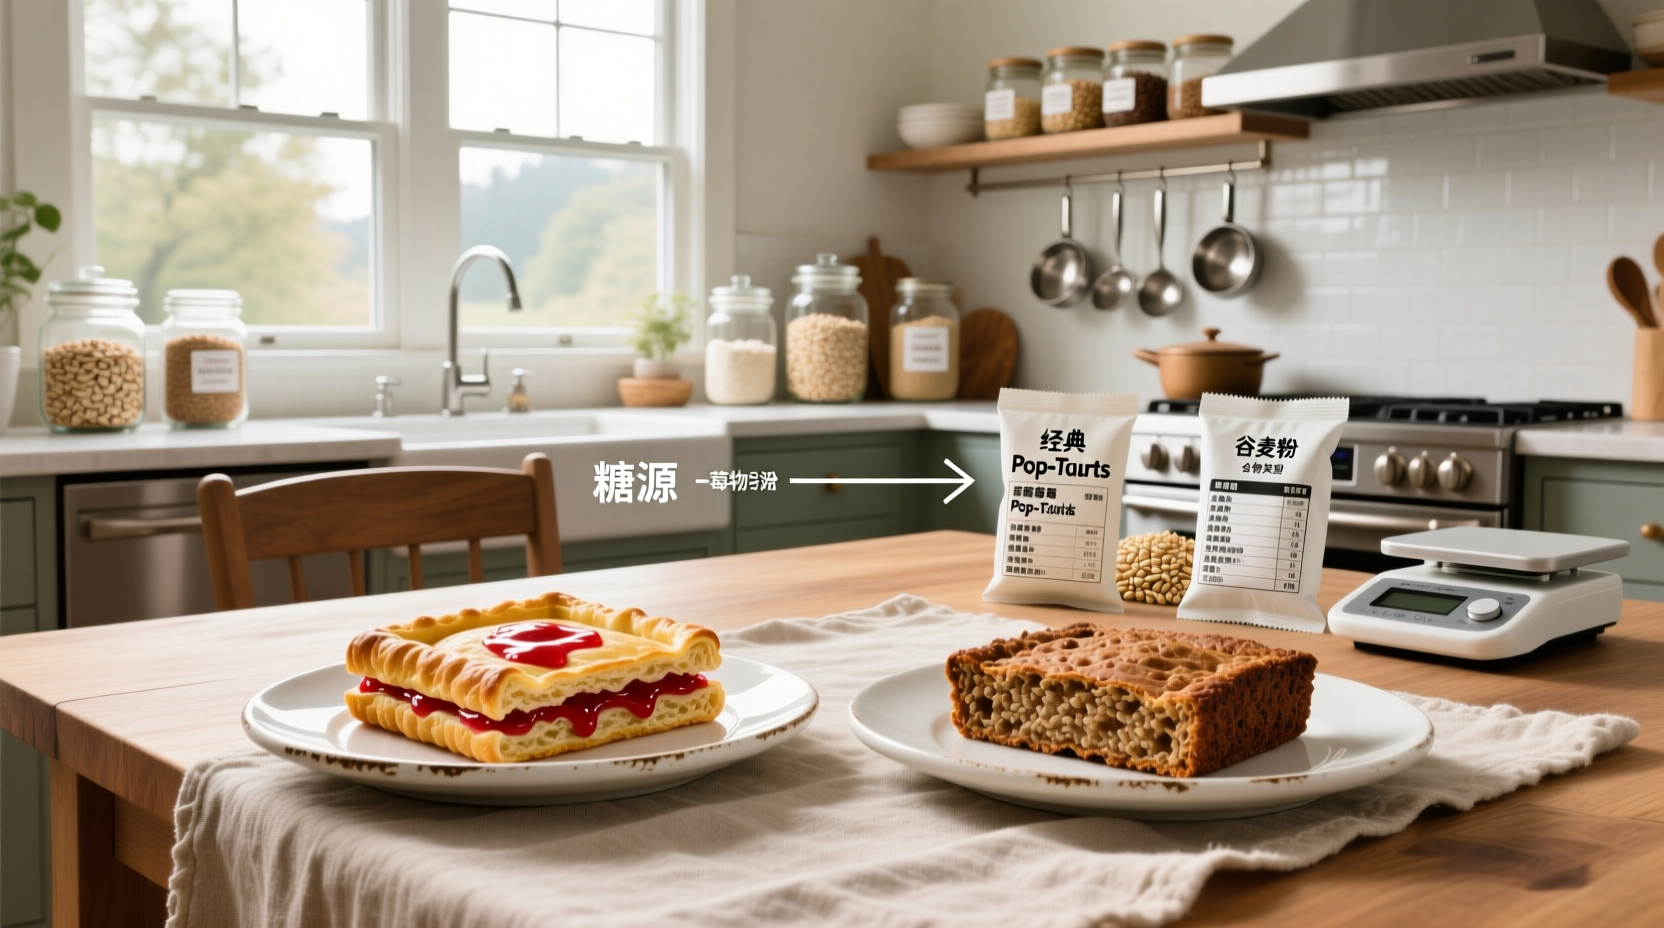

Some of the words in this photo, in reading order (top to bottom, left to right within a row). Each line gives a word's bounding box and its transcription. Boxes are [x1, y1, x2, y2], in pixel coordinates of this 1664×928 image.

[1040, 428, 1086, 453] 经典
[1235, 435, 1299, 459] 谷麦粉
